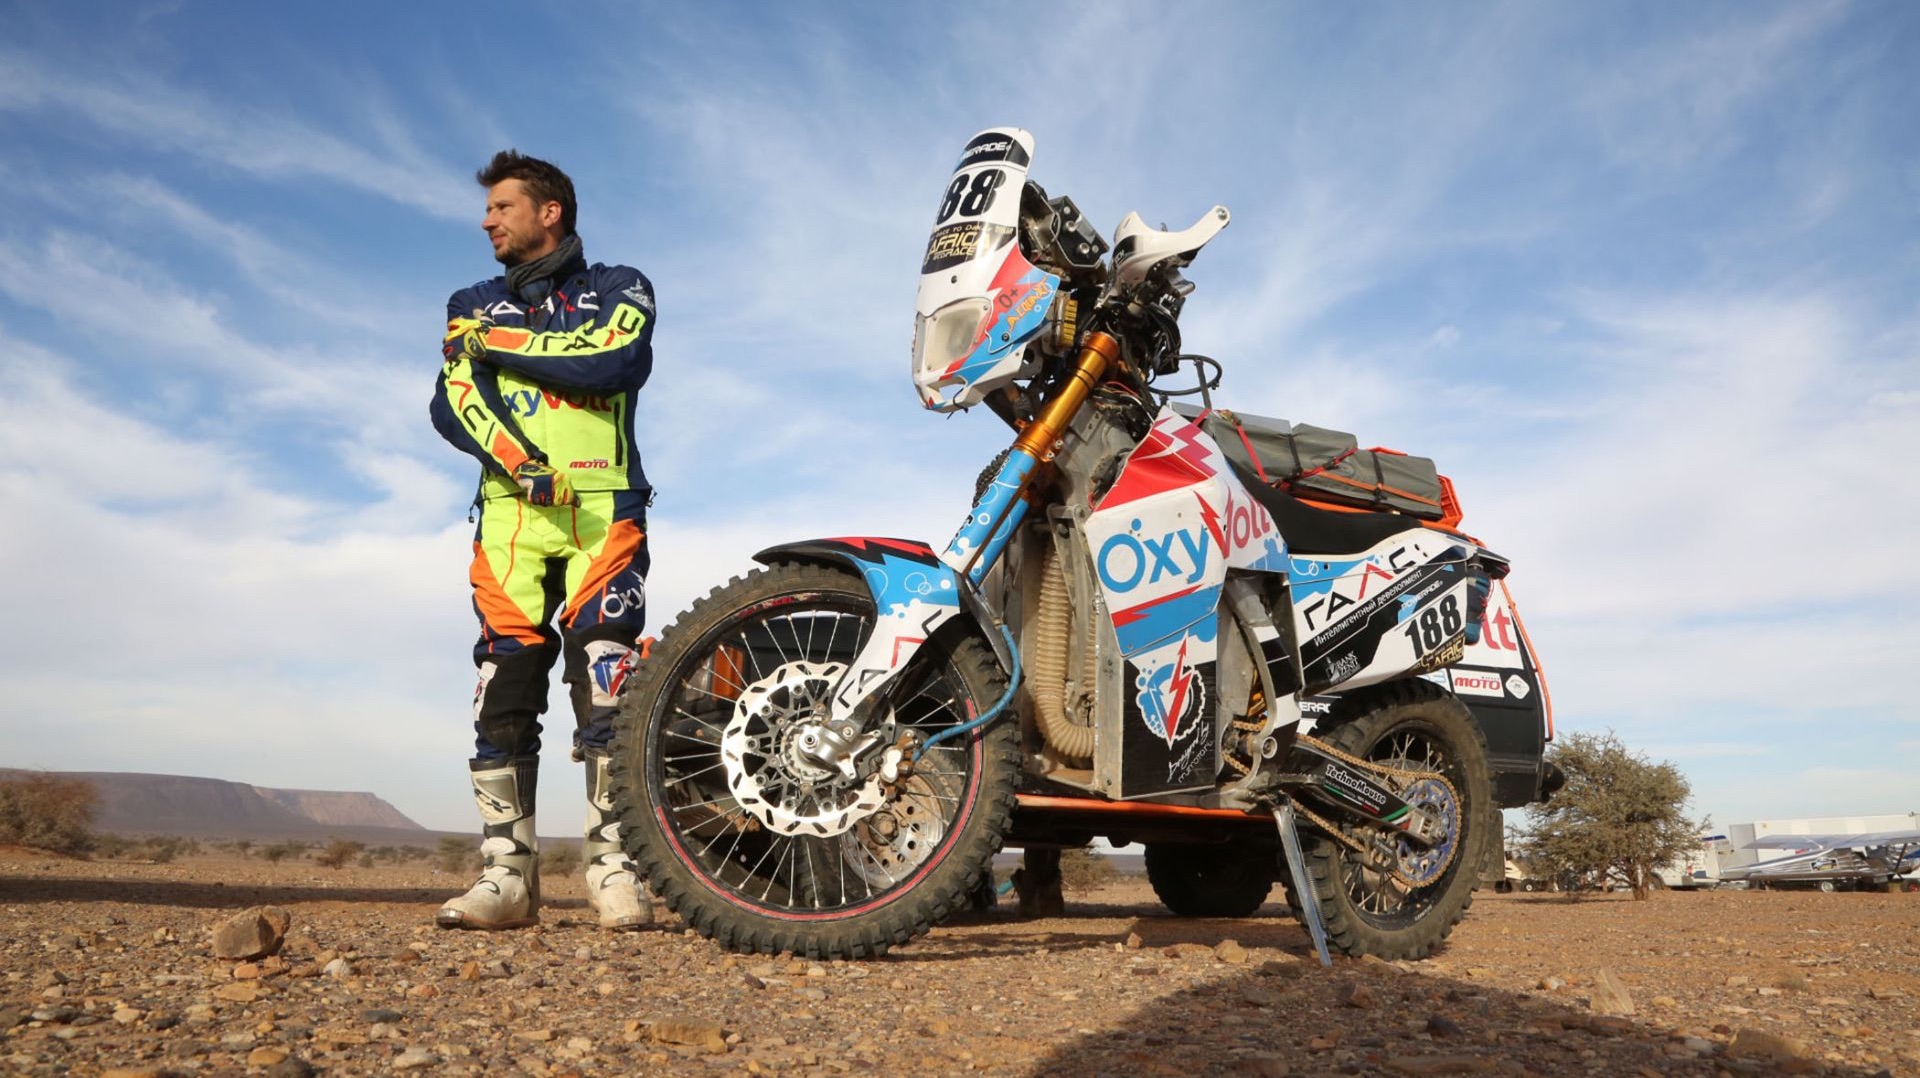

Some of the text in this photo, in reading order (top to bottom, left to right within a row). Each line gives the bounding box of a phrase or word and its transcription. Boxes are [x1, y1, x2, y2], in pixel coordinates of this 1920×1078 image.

[1313, 600, 1378, 648] Интеллигентный
[1376, 569, 1423, 607] девелопмент
[1404, 594, 1462, 661] 188
[1325, 763, 1387, 805] TechnoMousse
